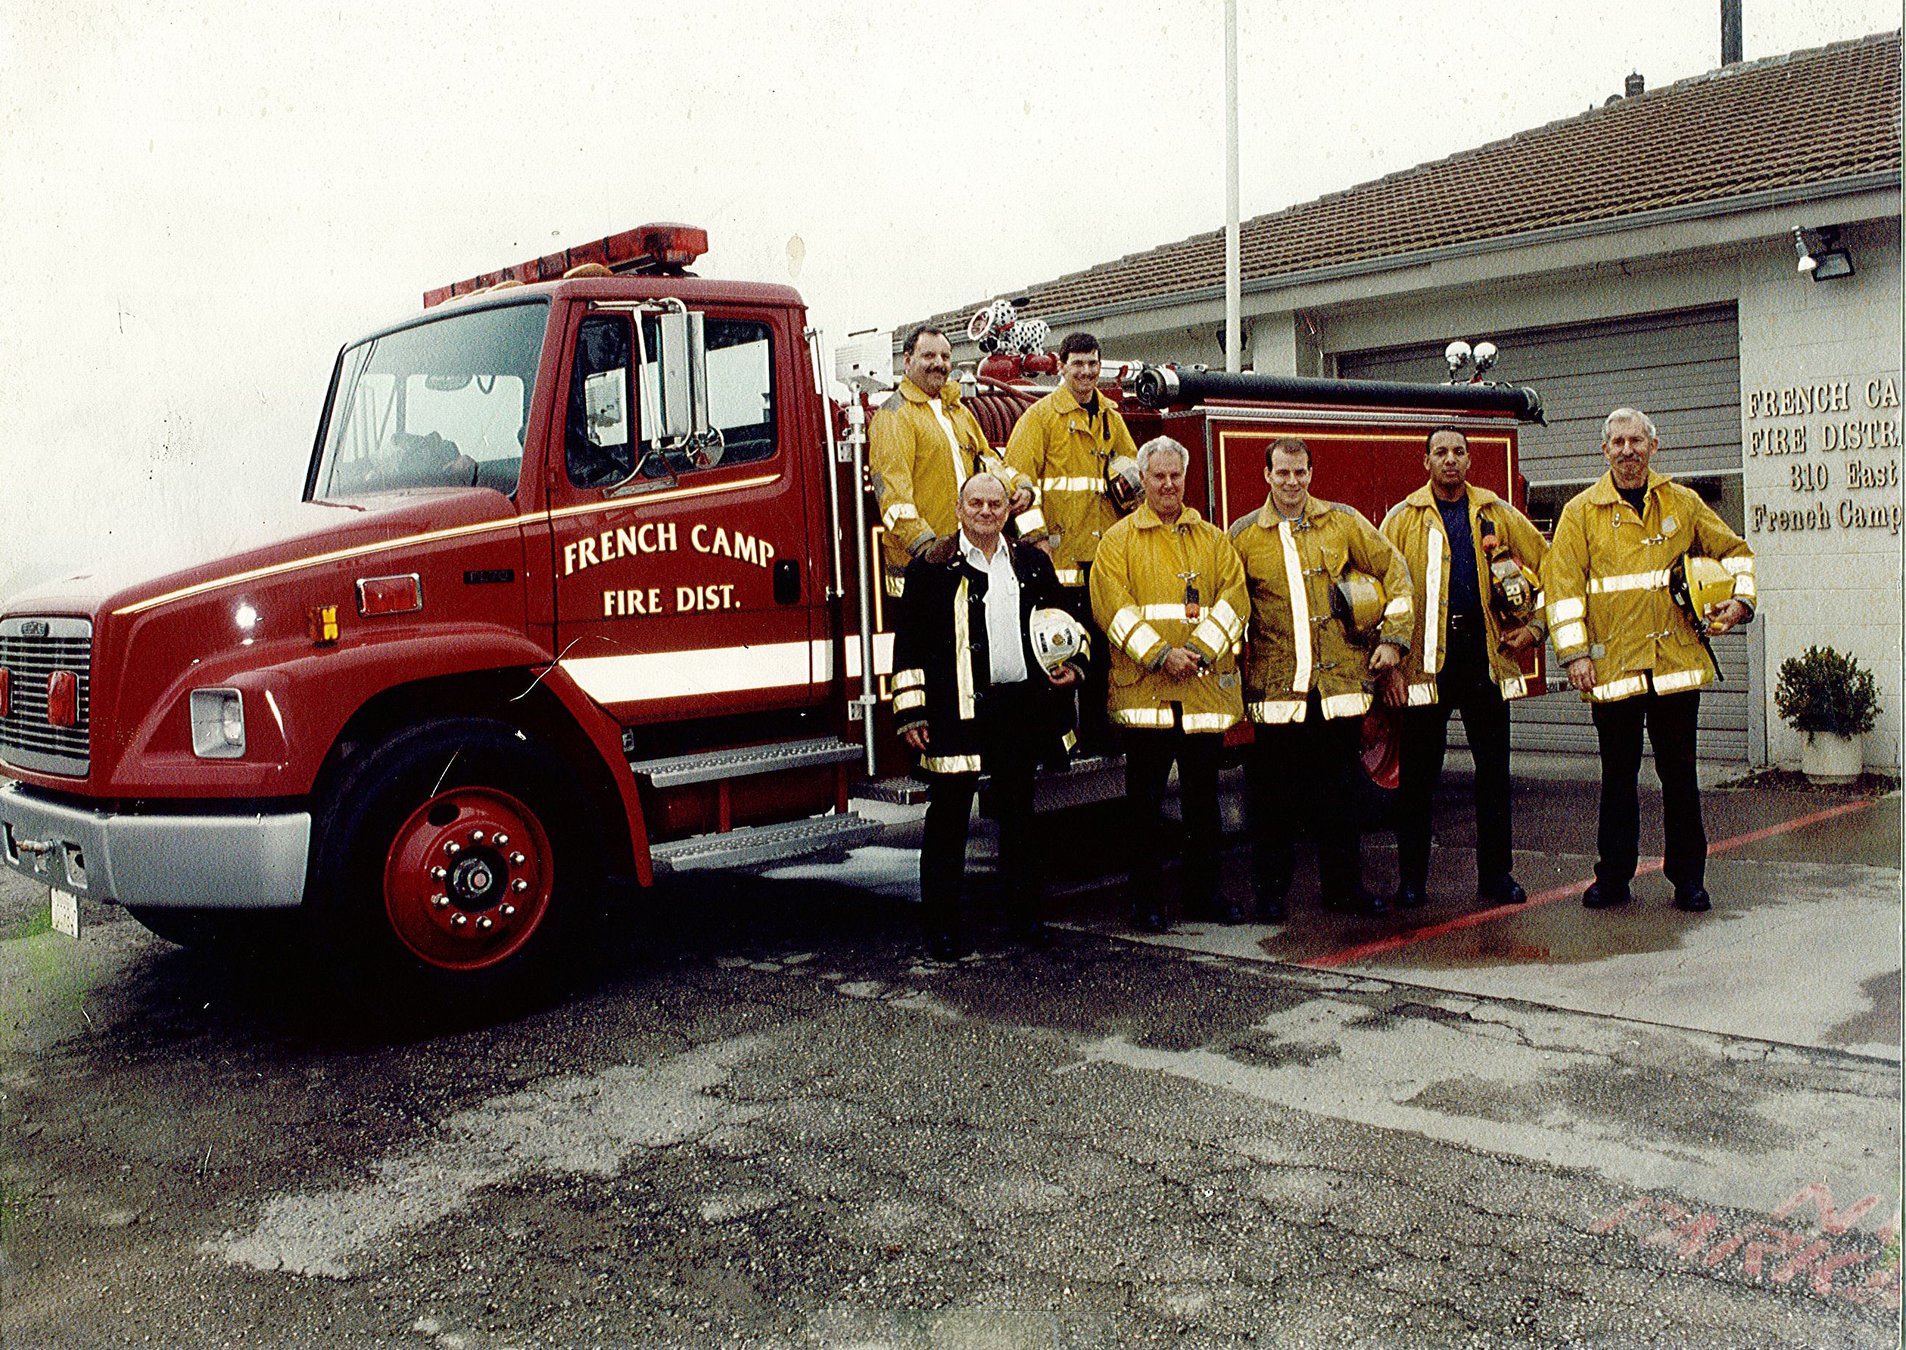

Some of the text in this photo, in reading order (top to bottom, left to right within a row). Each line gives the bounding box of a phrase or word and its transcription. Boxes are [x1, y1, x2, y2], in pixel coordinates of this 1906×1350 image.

[1748, 382, 1850, 418] FRENCH
[1750, 420, 1901, 457] FIRE DISTR
[1790, 460, 1898, 491] 310 East
[1751, 499, 1902, 535] French Camp
[563, 522, 775, 577] FRENCH CAMP
[603, 584, 741, 617] FIRE DIST.
